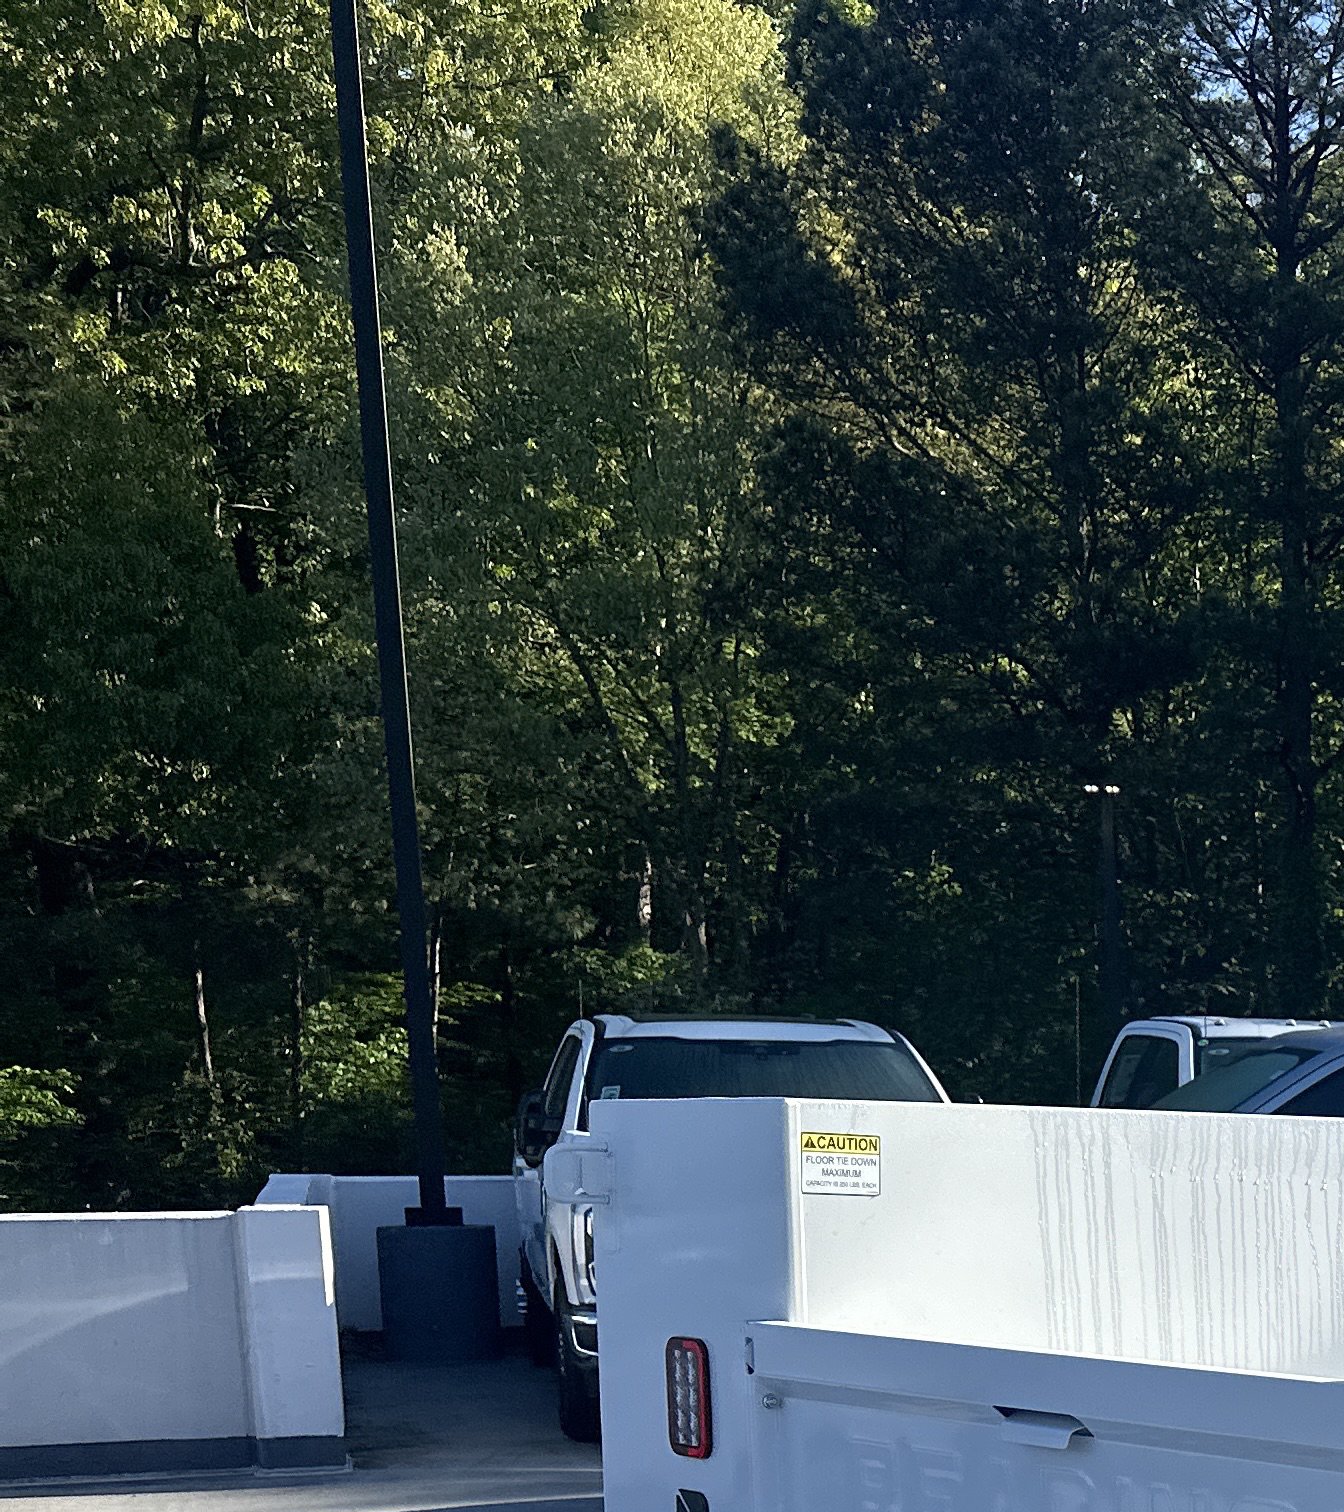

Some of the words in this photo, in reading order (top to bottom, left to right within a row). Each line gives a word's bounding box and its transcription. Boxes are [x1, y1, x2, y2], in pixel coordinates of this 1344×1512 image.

[817, 1136, 878, 1152] CAUTION
[805, 1155, 835, 1165] FLOOR
[836, 1156, 849, 1165] TIE
[851, 1157, 877, 1167] DOWN
[821, 1167, 862, 1178] MAXIMUM
